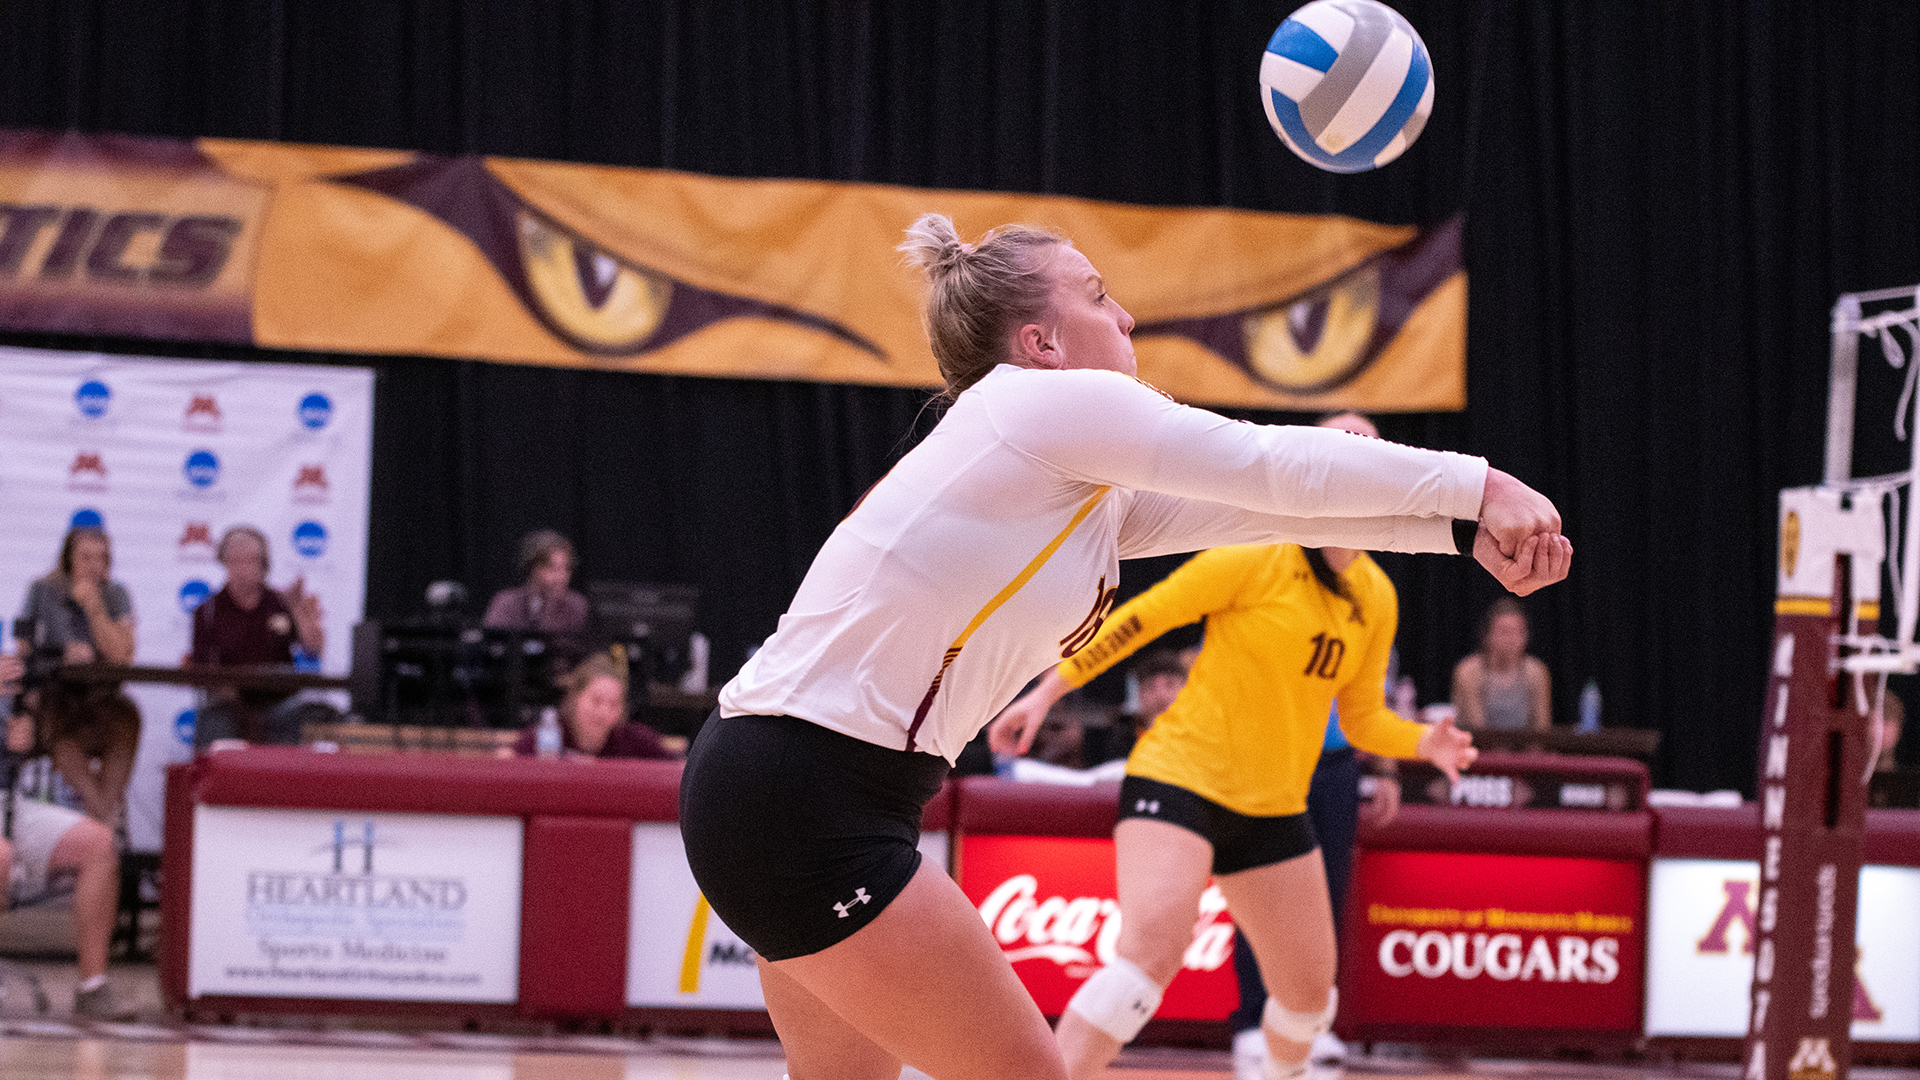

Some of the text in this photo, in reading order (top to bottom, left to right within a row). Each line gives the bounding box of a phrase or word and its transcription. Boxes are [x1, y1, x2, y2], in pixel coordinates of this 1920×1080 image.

[1304, 631, 1346, 679] 10
[247, 871, 468, 912] HEARTLAND
[1378, 929, 1620, 984] COUGARS
